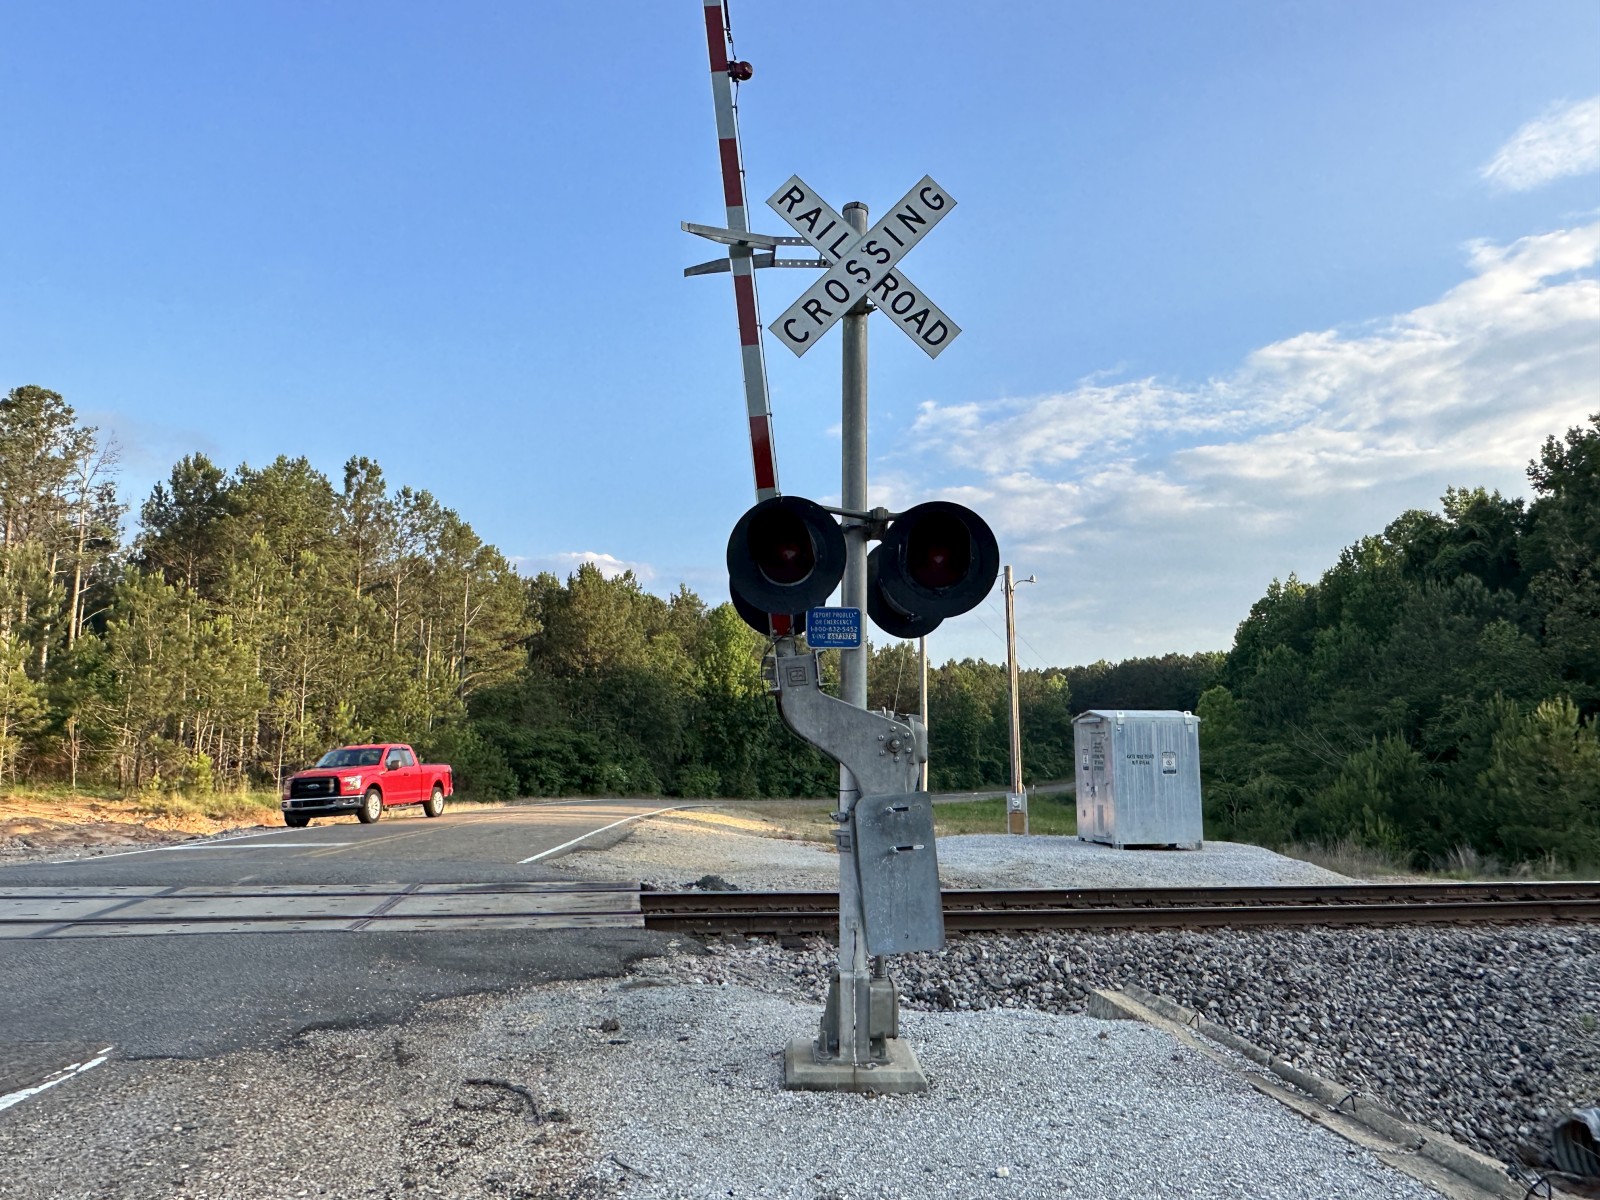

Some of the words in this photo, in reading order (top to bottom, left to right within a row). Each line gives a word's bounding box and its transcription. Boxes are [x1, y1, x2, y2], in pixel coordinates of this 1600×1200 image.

[777, 184, 849, 260] RAIL
[783, 186, 945, 343] CROSSING
[871, 272, 949, 346] ROAD
